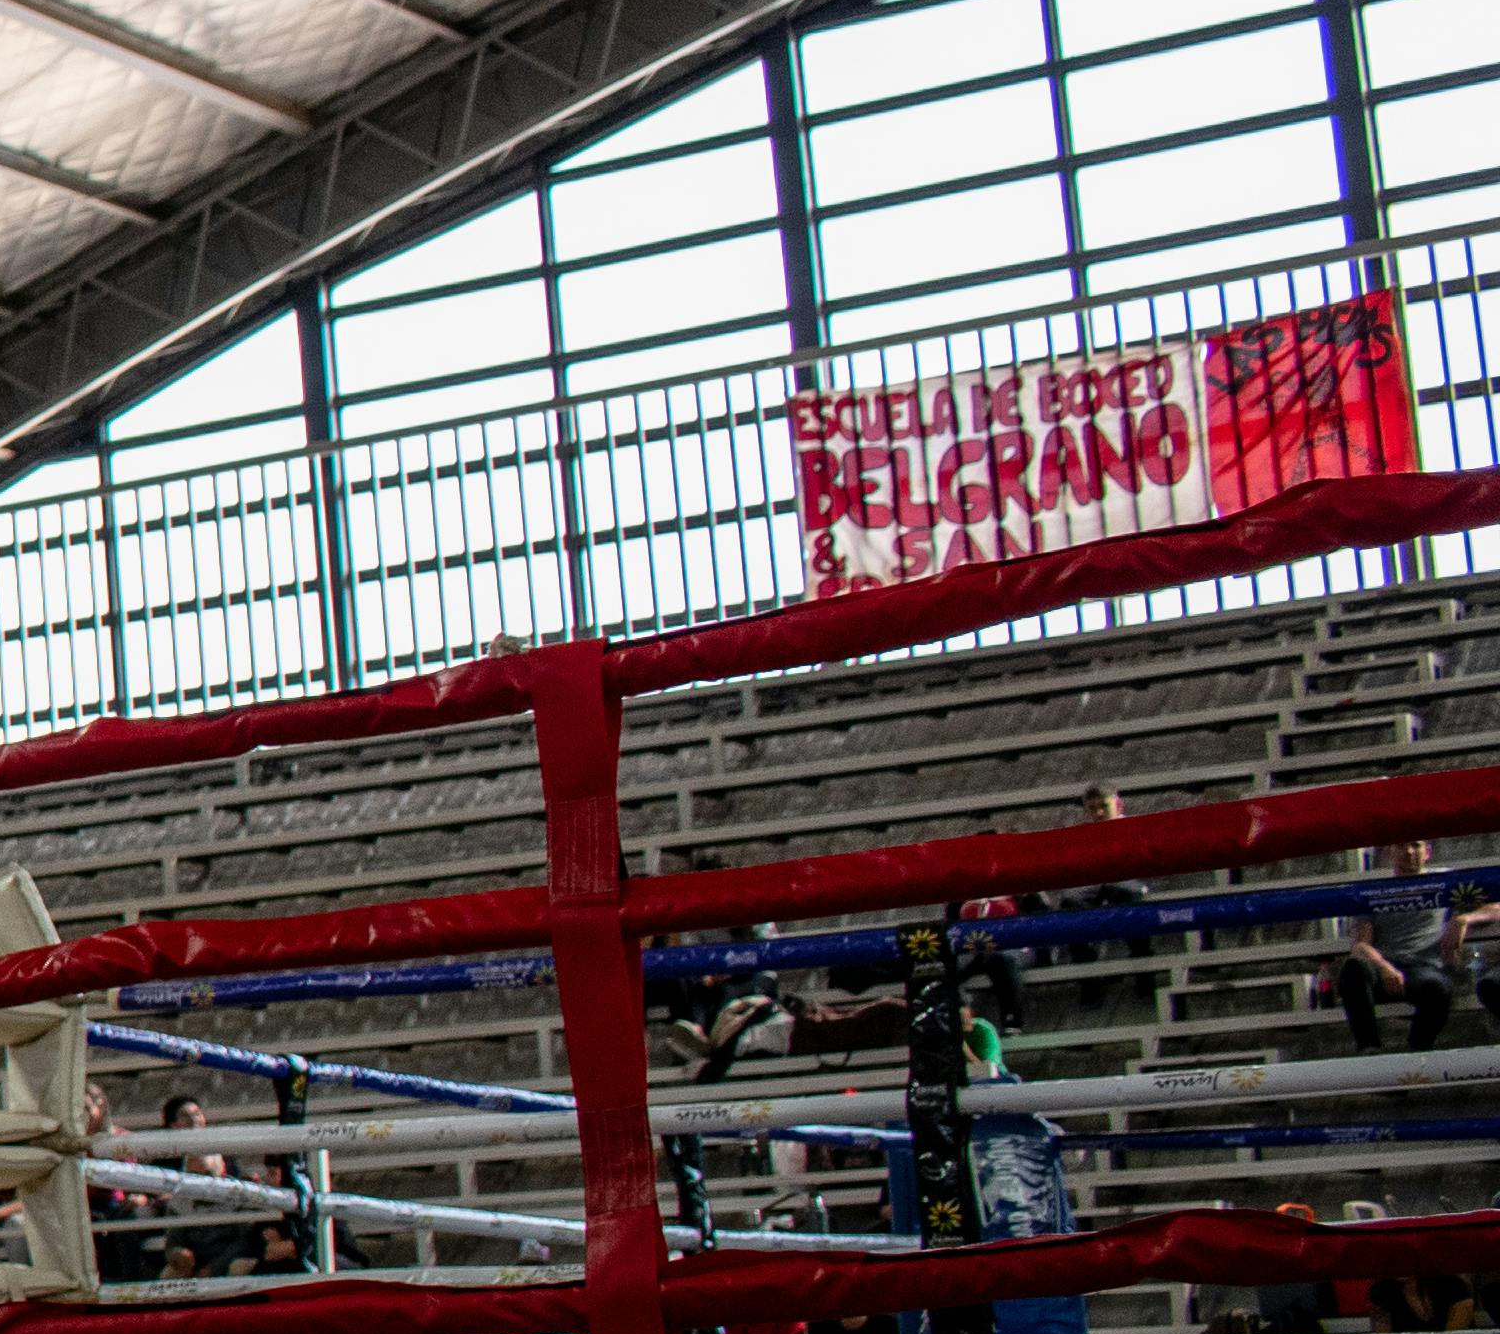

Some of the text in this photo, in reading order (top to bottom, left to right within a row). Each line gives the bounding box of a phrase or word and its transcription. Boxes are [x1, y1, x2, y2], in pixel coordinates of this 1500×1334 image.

[788, 389, 956, 441] ESCUELA
[972, 378, 1023, 434] DE
[802, 403, 1190, 531] BELGRANO
